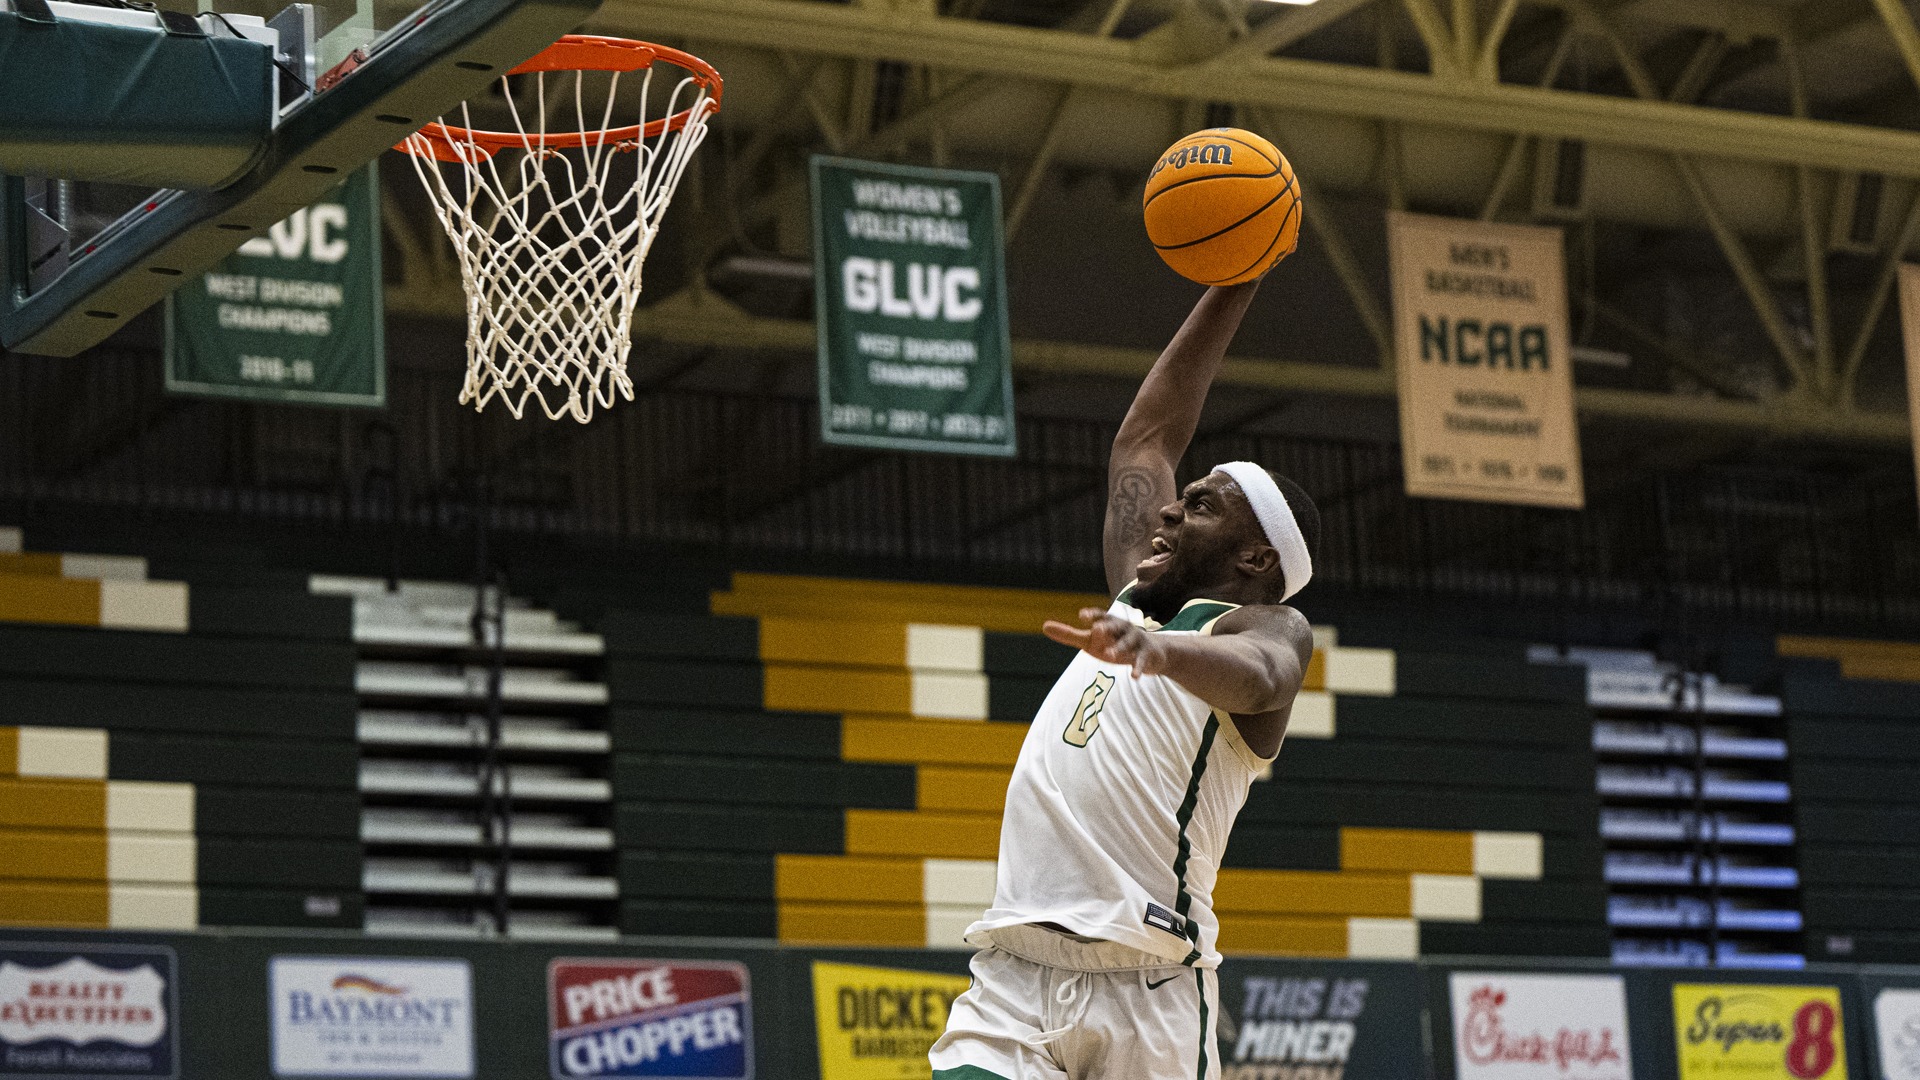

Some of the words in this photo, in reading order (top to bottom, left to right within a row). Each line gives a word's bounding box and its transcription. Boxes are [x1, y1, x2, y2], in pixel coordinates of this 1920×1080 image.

[852, 179, 963, 217] WOMEN'S
[843, 209, 971, 250] VOLLEYBALL
[842, 256, 984, 321] GLVC
[1419, 315, 1549, 371] NCAA
[1062, 671, 1115, 749] 0
[29, 982, 124, 1001] REALTY
[290, 989, 459, 1026] BAYMONT
[564, 964, 679, 1024] PRICE
[1243, 976, 1326, 1018] THIS
[1327, 977, 1368, 1018] IS
[564, 1007, 742, 1075] CHOPPER
[1234, 1020, 1356, 1062] MINER
[1687, 997, 1784, 1054] Super
[1785, 998, 1836, 1080] 8
